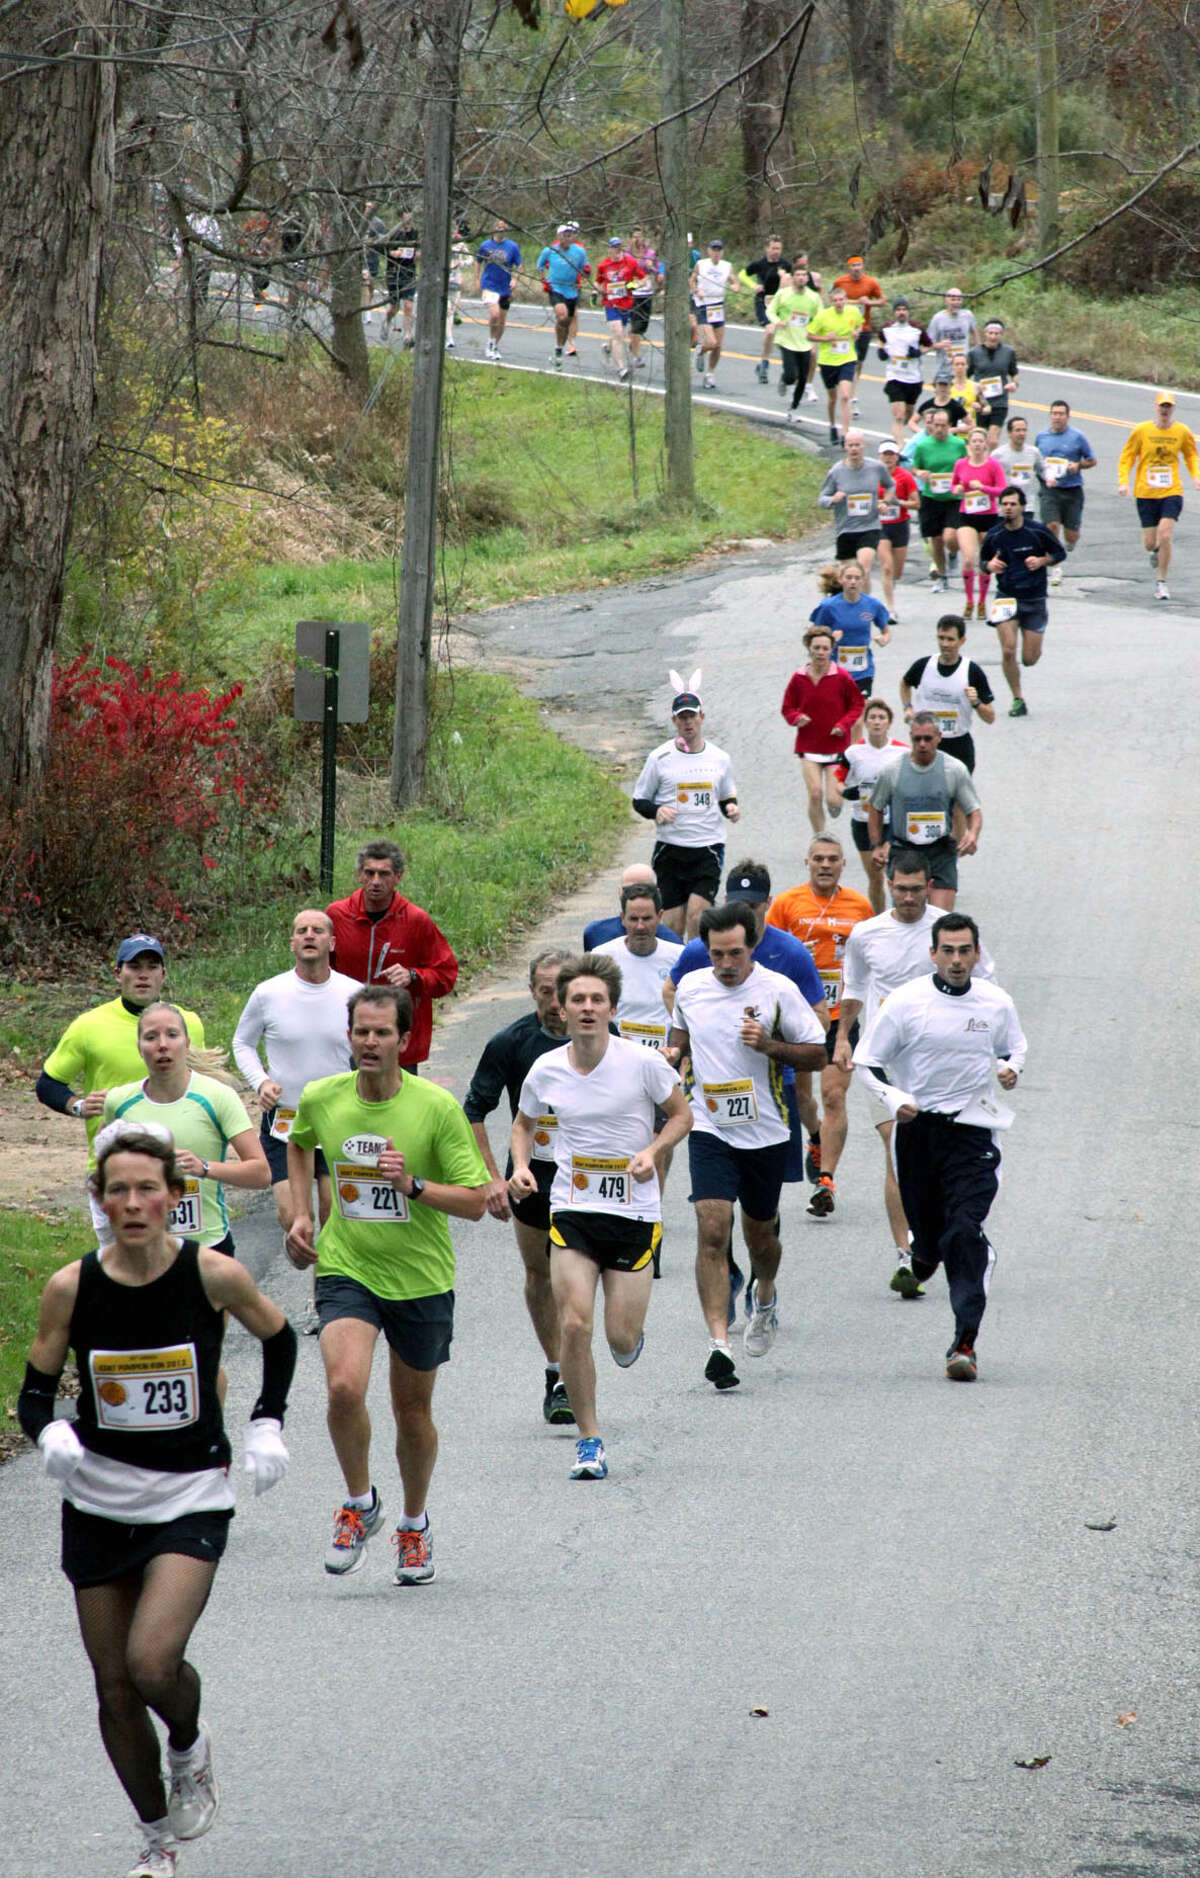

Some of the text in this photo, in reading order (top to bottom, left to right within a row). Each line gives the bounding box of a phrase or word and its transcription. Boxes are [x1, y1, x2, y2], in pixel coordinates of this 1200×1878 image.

[694, 793, 710, 806] 348
[727, 1097, 750, 1117] 227
[599, 1176, 625, 1198] 479
[372, 1187, 399, 1210] 221
[143, 1379, 188, 1415] 233
